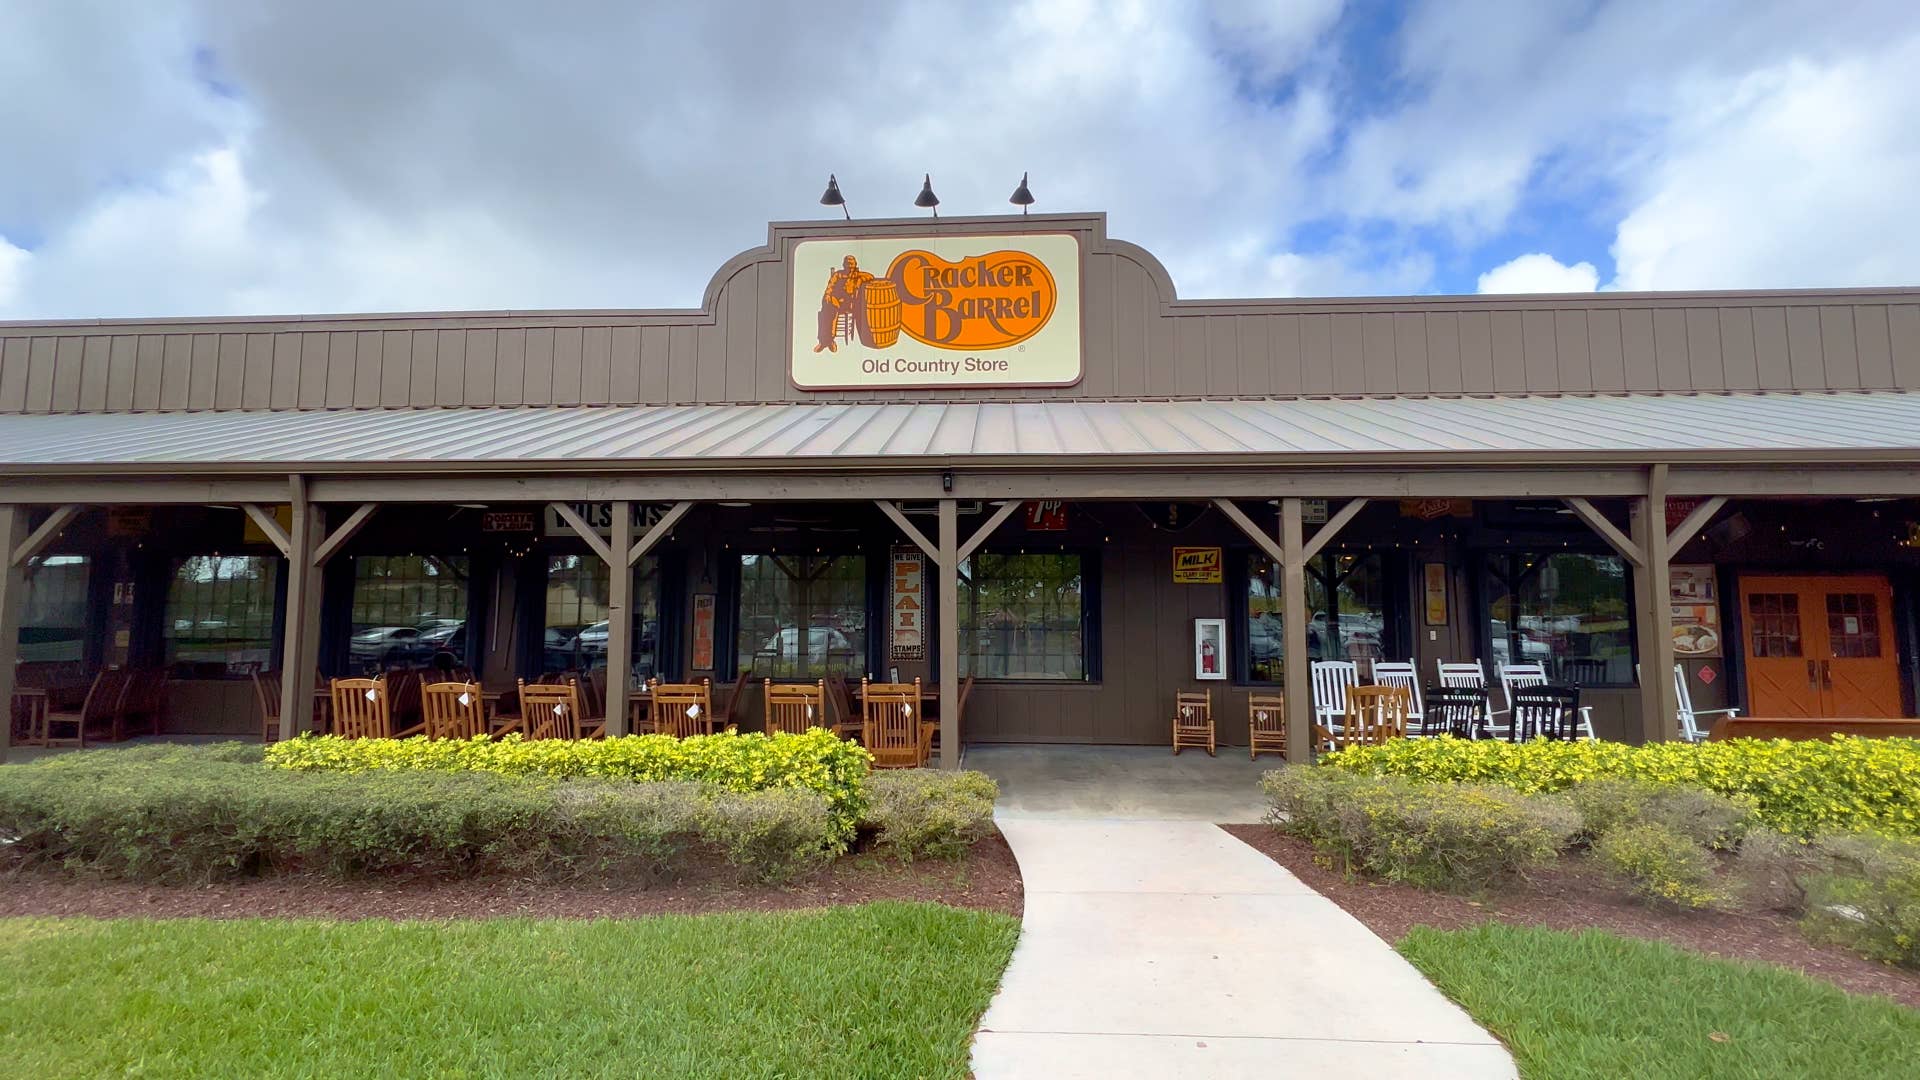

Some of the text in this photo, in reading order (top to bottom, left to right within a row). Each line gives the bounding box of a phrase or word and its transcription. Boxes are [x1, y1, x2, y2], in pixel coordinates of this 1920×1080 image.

[895, 254, 1034, 305] Cracker
[923, 288, 1041, 343] Barrel
[862, 357, 1008, 376] Old Country Store
[1182, 553, 1214, 566] MILK
[895, 562, 920, 641] PLAID
